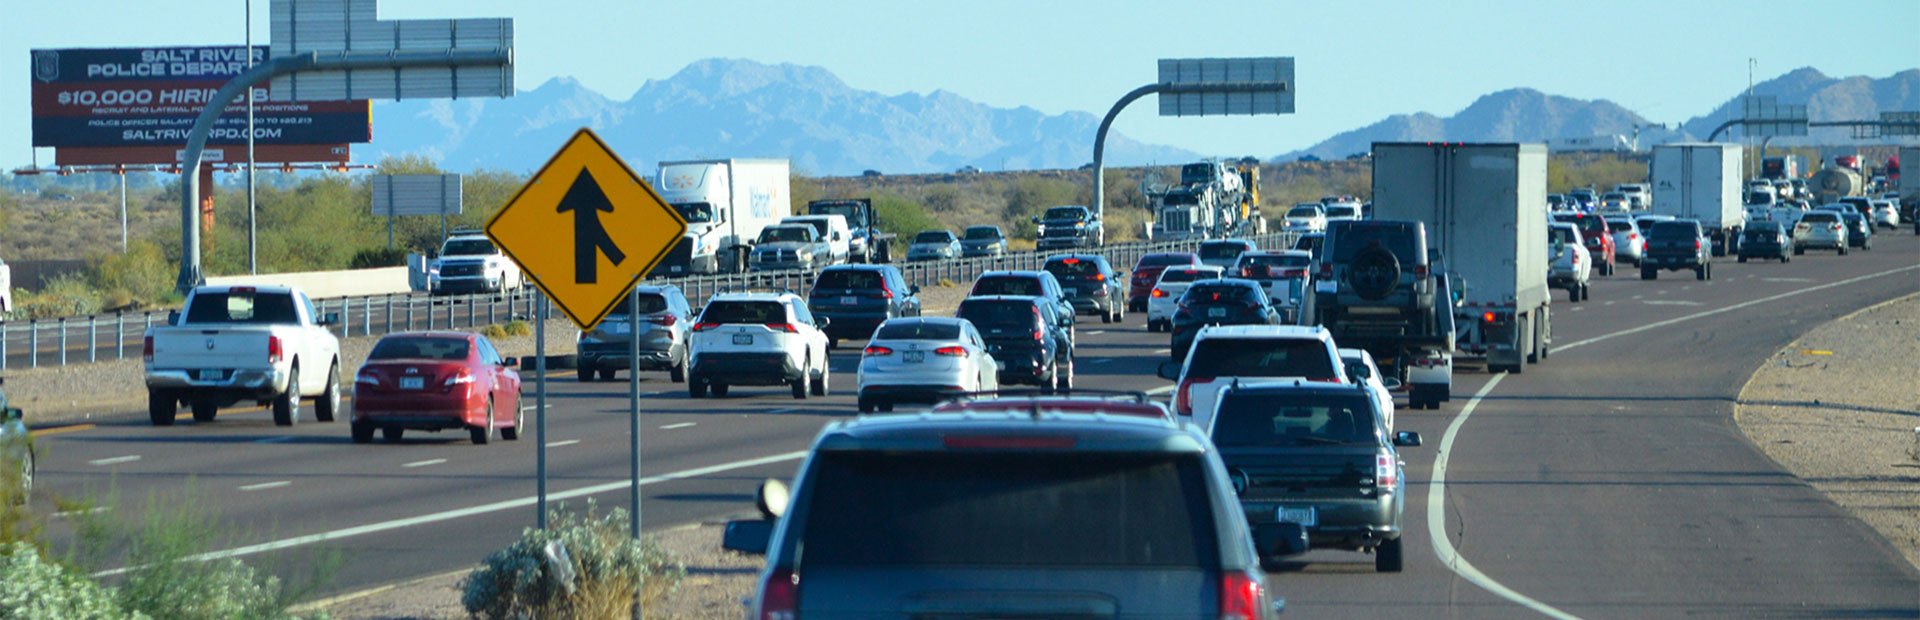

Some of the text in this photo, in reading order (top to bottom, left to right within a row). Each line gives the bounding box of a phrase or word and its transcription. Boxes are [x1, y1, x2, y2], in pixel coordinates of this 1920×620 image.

[141, 48, 264, 62] SALT RIVER
[87, 64, 165, 77] POLICE
[58, 89, 152, 106] $10,000
[92, 106, 128, 114] RECRUIT
[262, 104, 309, 112] POSITIONS
